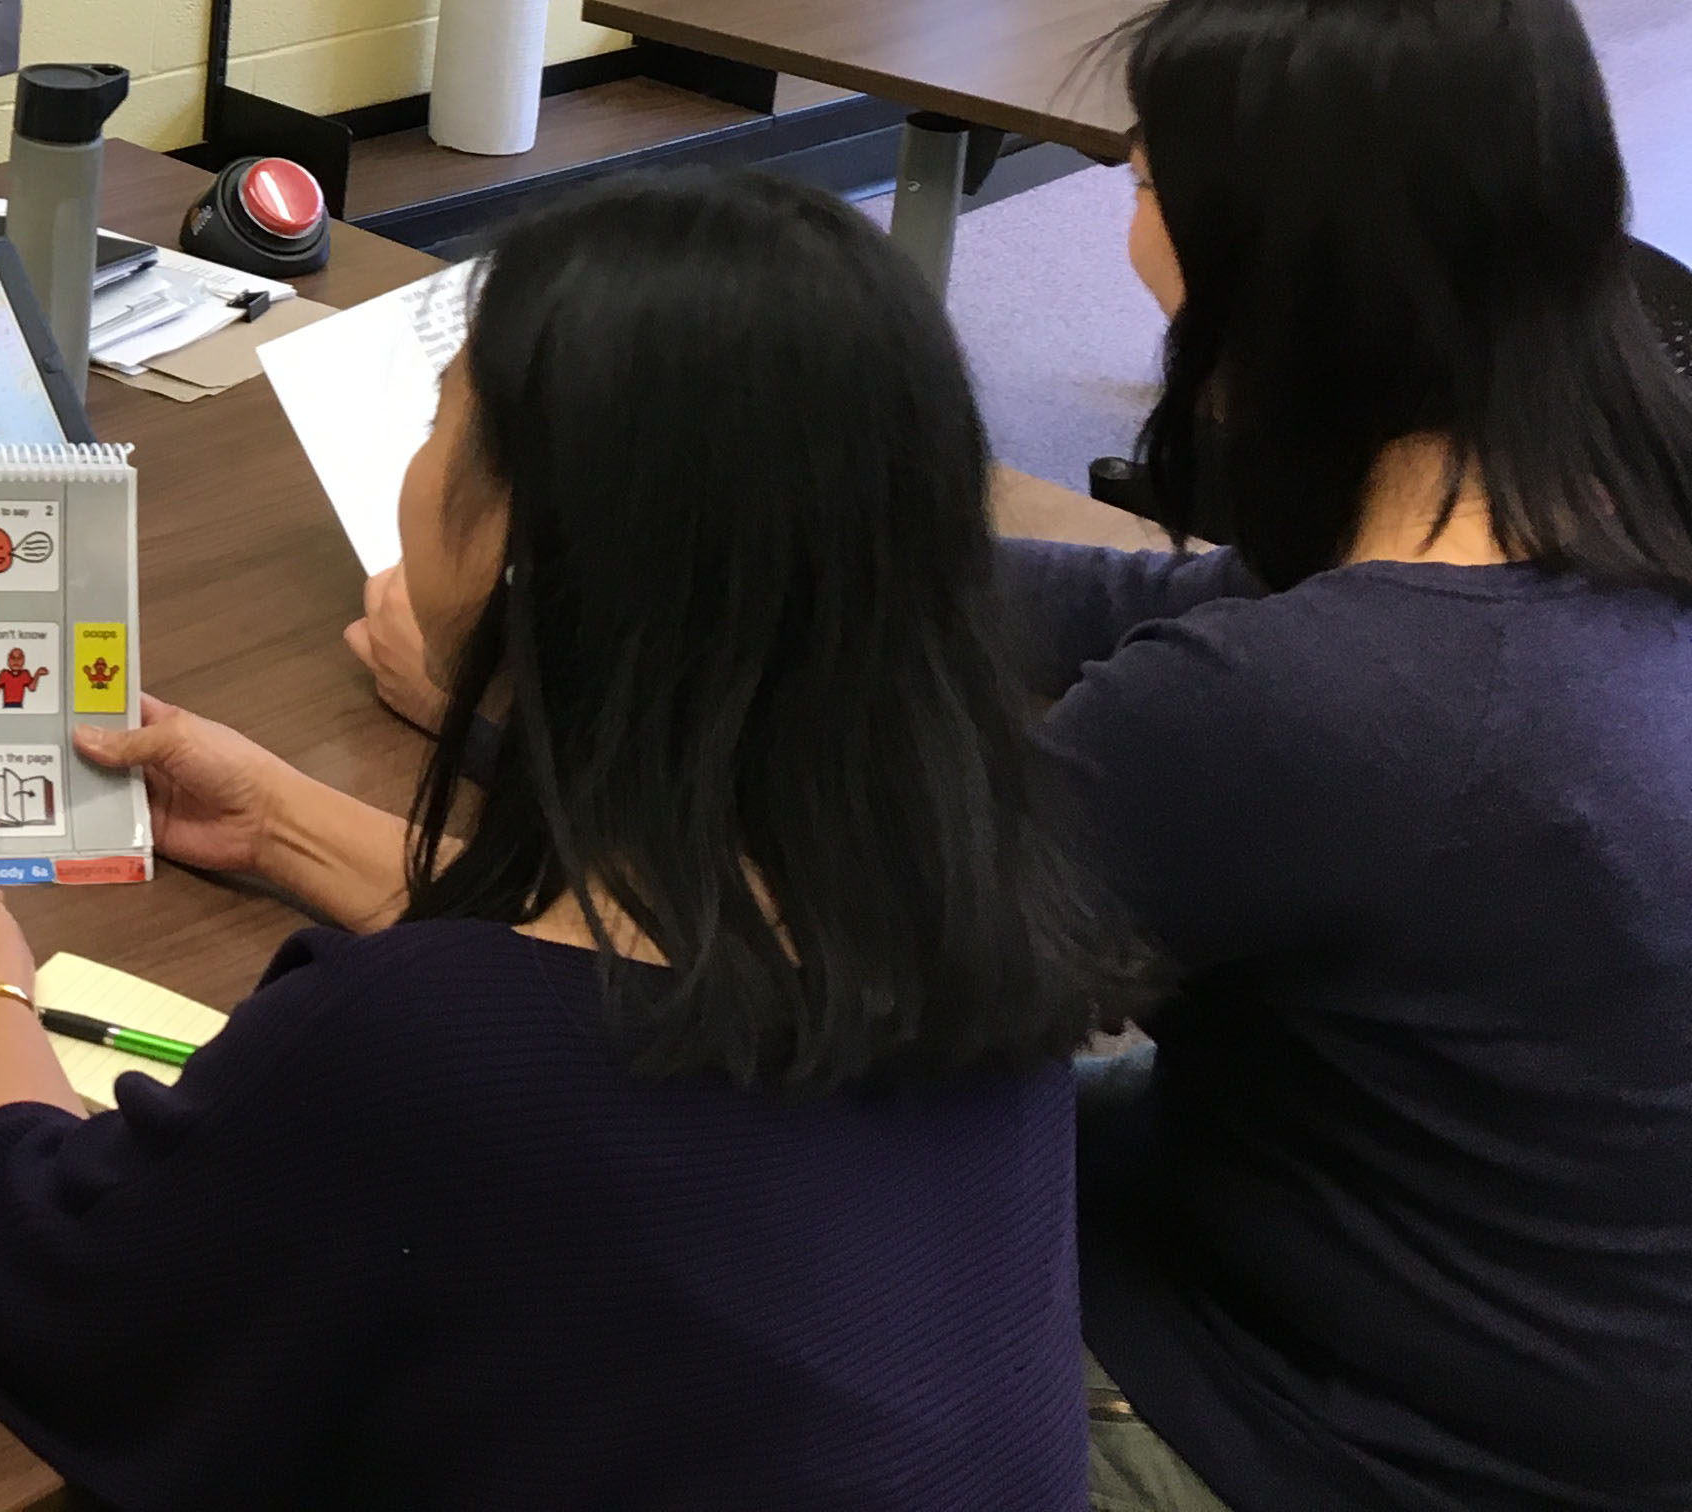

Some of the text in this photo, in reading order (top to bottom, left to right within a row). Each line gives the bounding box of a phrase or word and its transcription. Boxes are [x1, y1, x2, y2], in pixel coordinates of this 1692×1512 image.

[45, 505, 54, 516] 2
[18, 630, 48, 639] know
[7, 753, 25, 763] the
[27, 754, 54, 765] page
